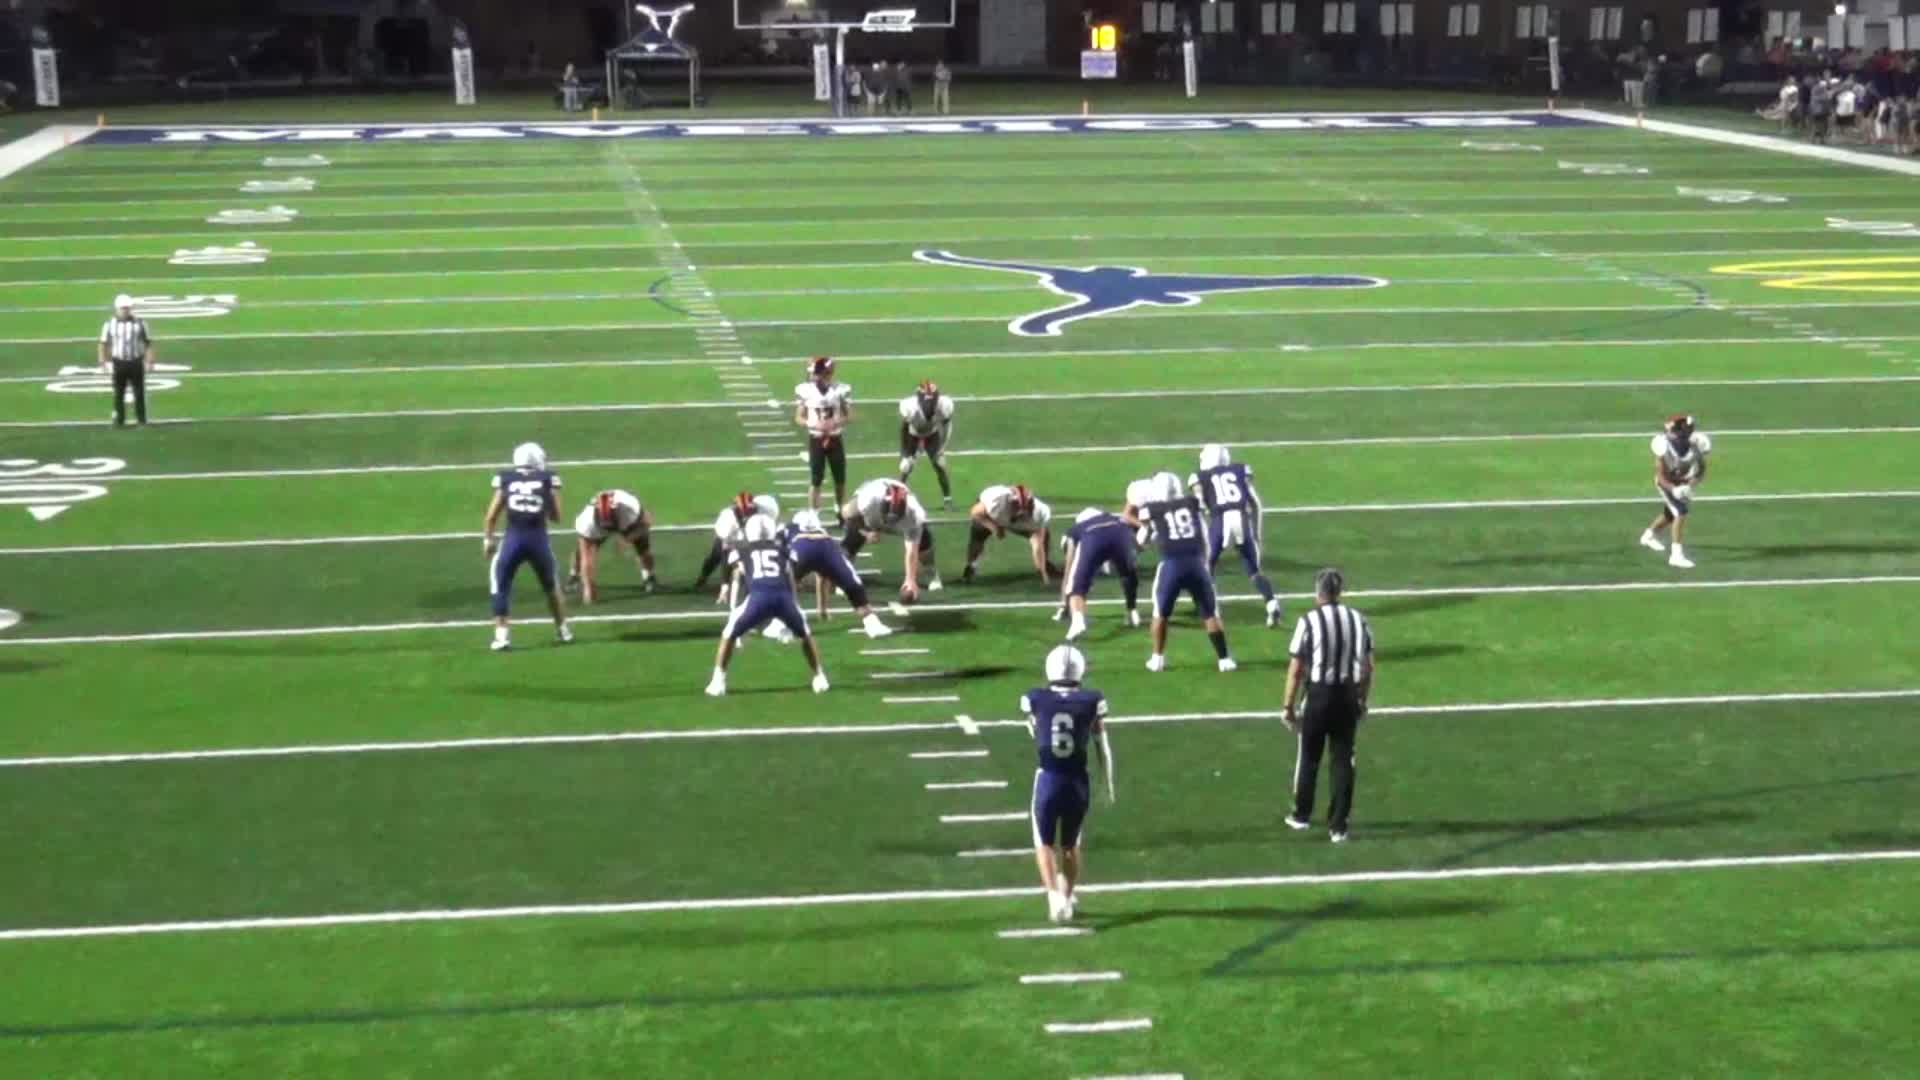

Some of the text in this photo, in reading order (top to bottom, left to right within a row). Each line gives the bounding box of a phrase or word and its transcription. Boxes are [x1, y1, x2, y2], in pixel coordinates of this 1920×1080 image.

[153, 117, 1537, 142] MAVERICKS
[0, 457, 127, 504] 30
[509, 480, 544, 512] 25
[1210, 472, 1243, 505] 16
[1163, 507, 1196, 539] 18
[751, 549, 781, 578] 15
[1051, 711, 1075, 758] 6
